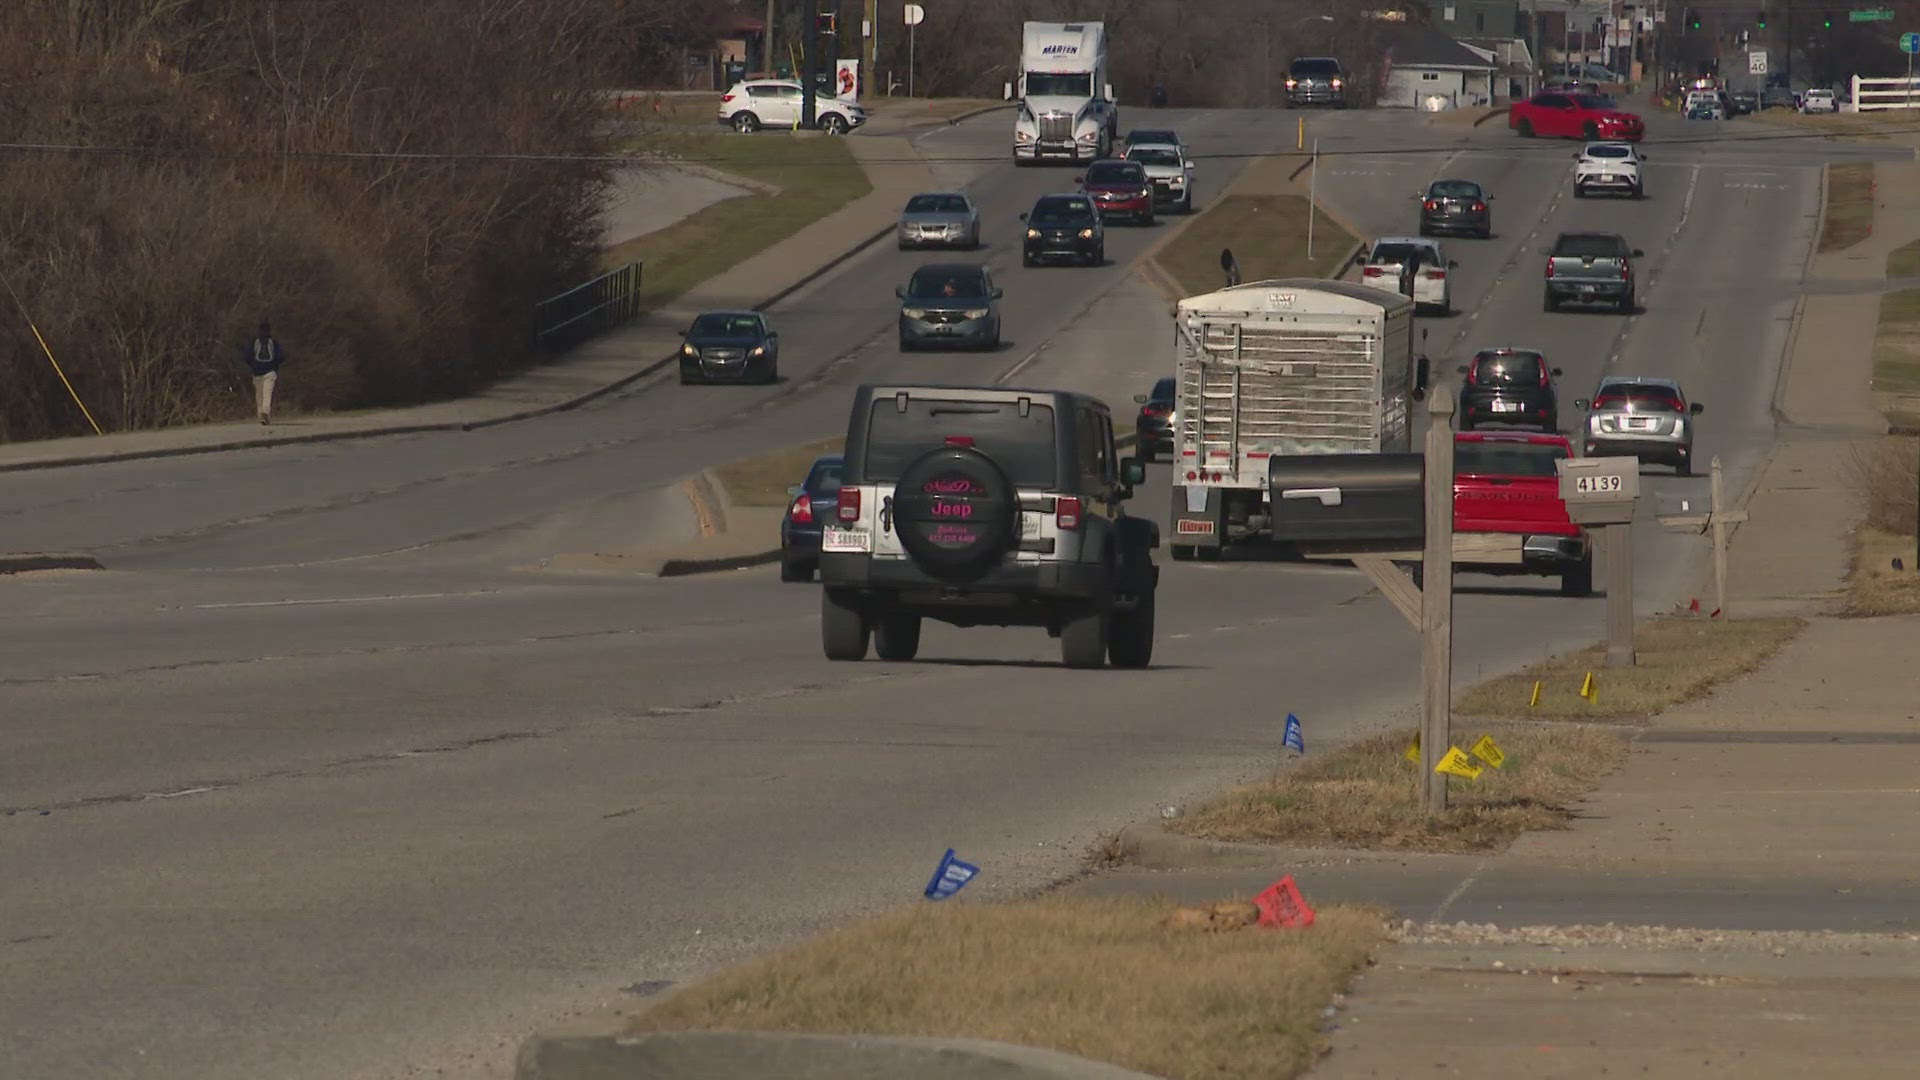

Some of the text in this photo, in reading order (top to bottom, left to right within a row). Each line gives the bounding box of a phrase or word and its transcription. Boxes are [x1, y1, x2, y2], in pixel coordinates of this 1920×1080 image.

[1042, 45, 1078, 55] MARTEN
[1751, 63, 1766, 72] 40
[1579, 477, 1620, 491] 4139
[931, 501, 972, 519] Jeep
